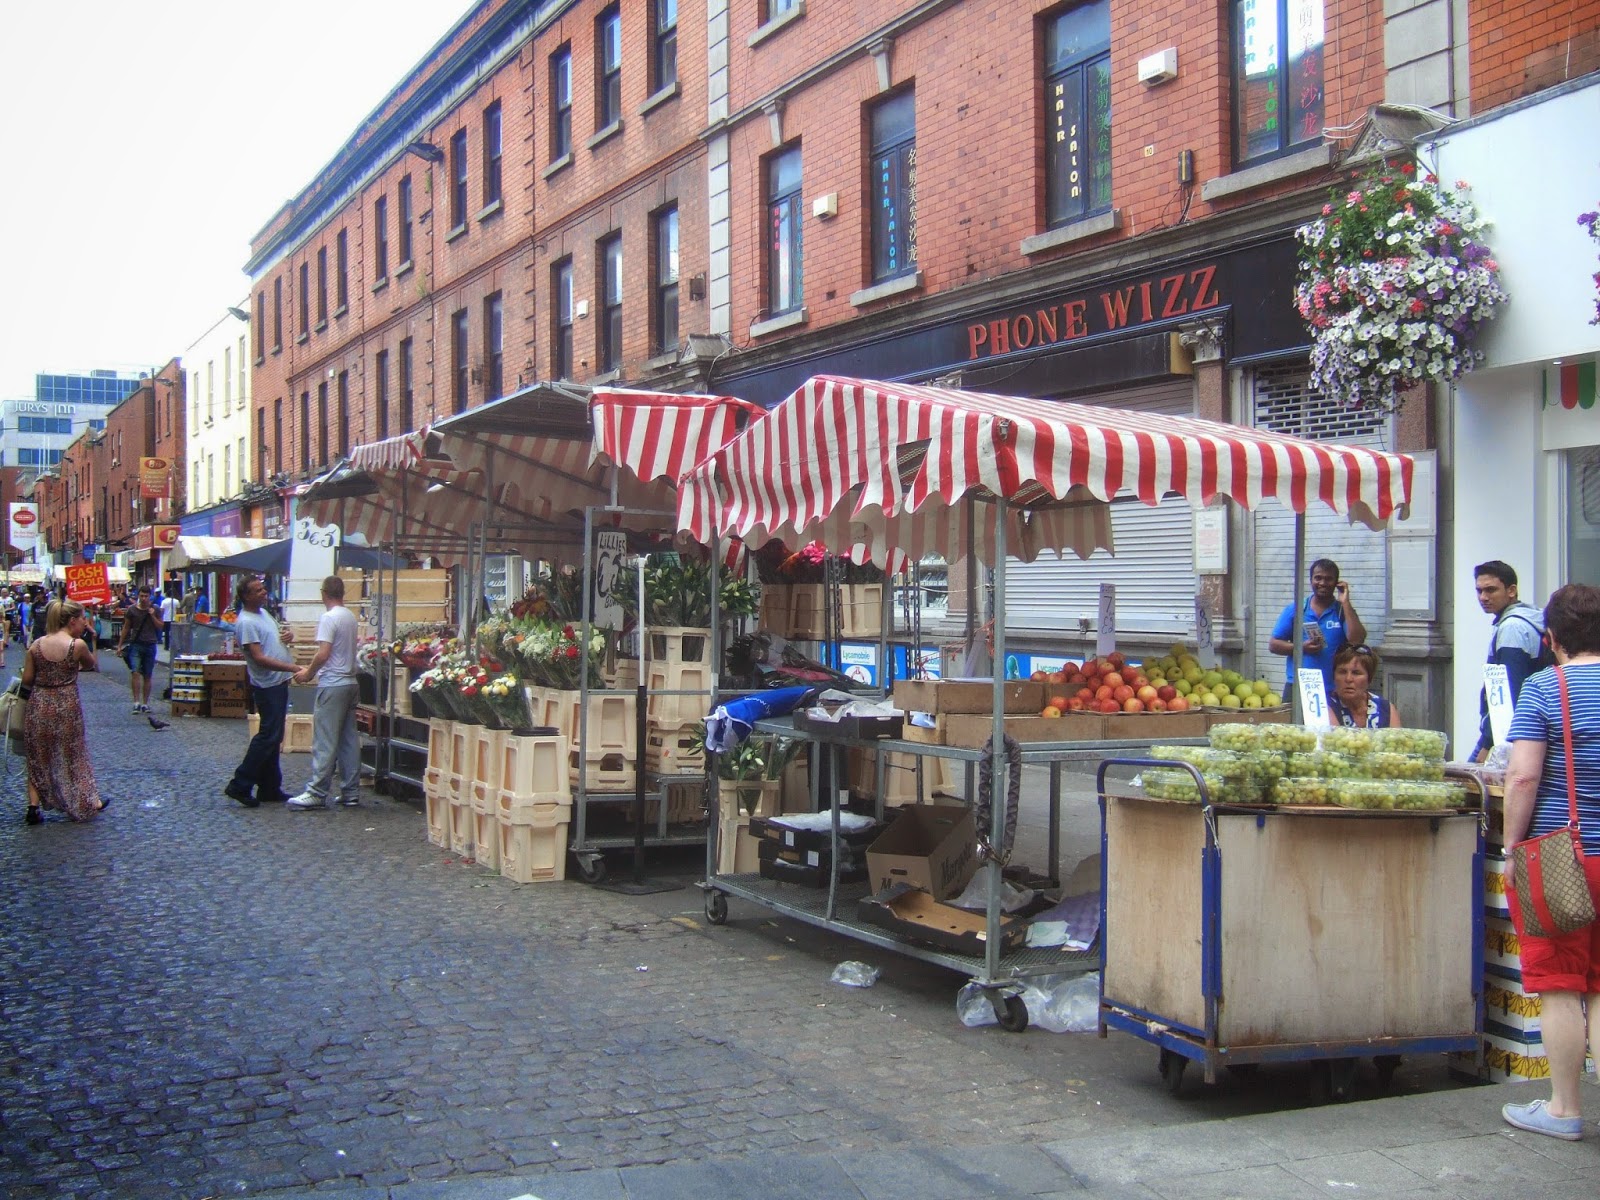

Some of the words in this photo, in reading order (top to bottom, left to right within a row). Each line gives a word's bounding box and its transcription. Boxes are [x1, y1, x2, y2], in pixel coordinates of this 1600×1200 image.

[1055, 84, 1065, 142] HAIR
[1070, 125, 1079, 197] SALON
[882, 160, 890, 208] HAIR
[967, 299, 1088, 360] PHONE
[1100, 265, 1220, 331] WIZZ
[15, 401, 48, 413] JURYS
[68, 565, 103, 580] CASH
[1104, 596, 1112, 613] 7
[842, 650, 870, 660] Lycamobile
